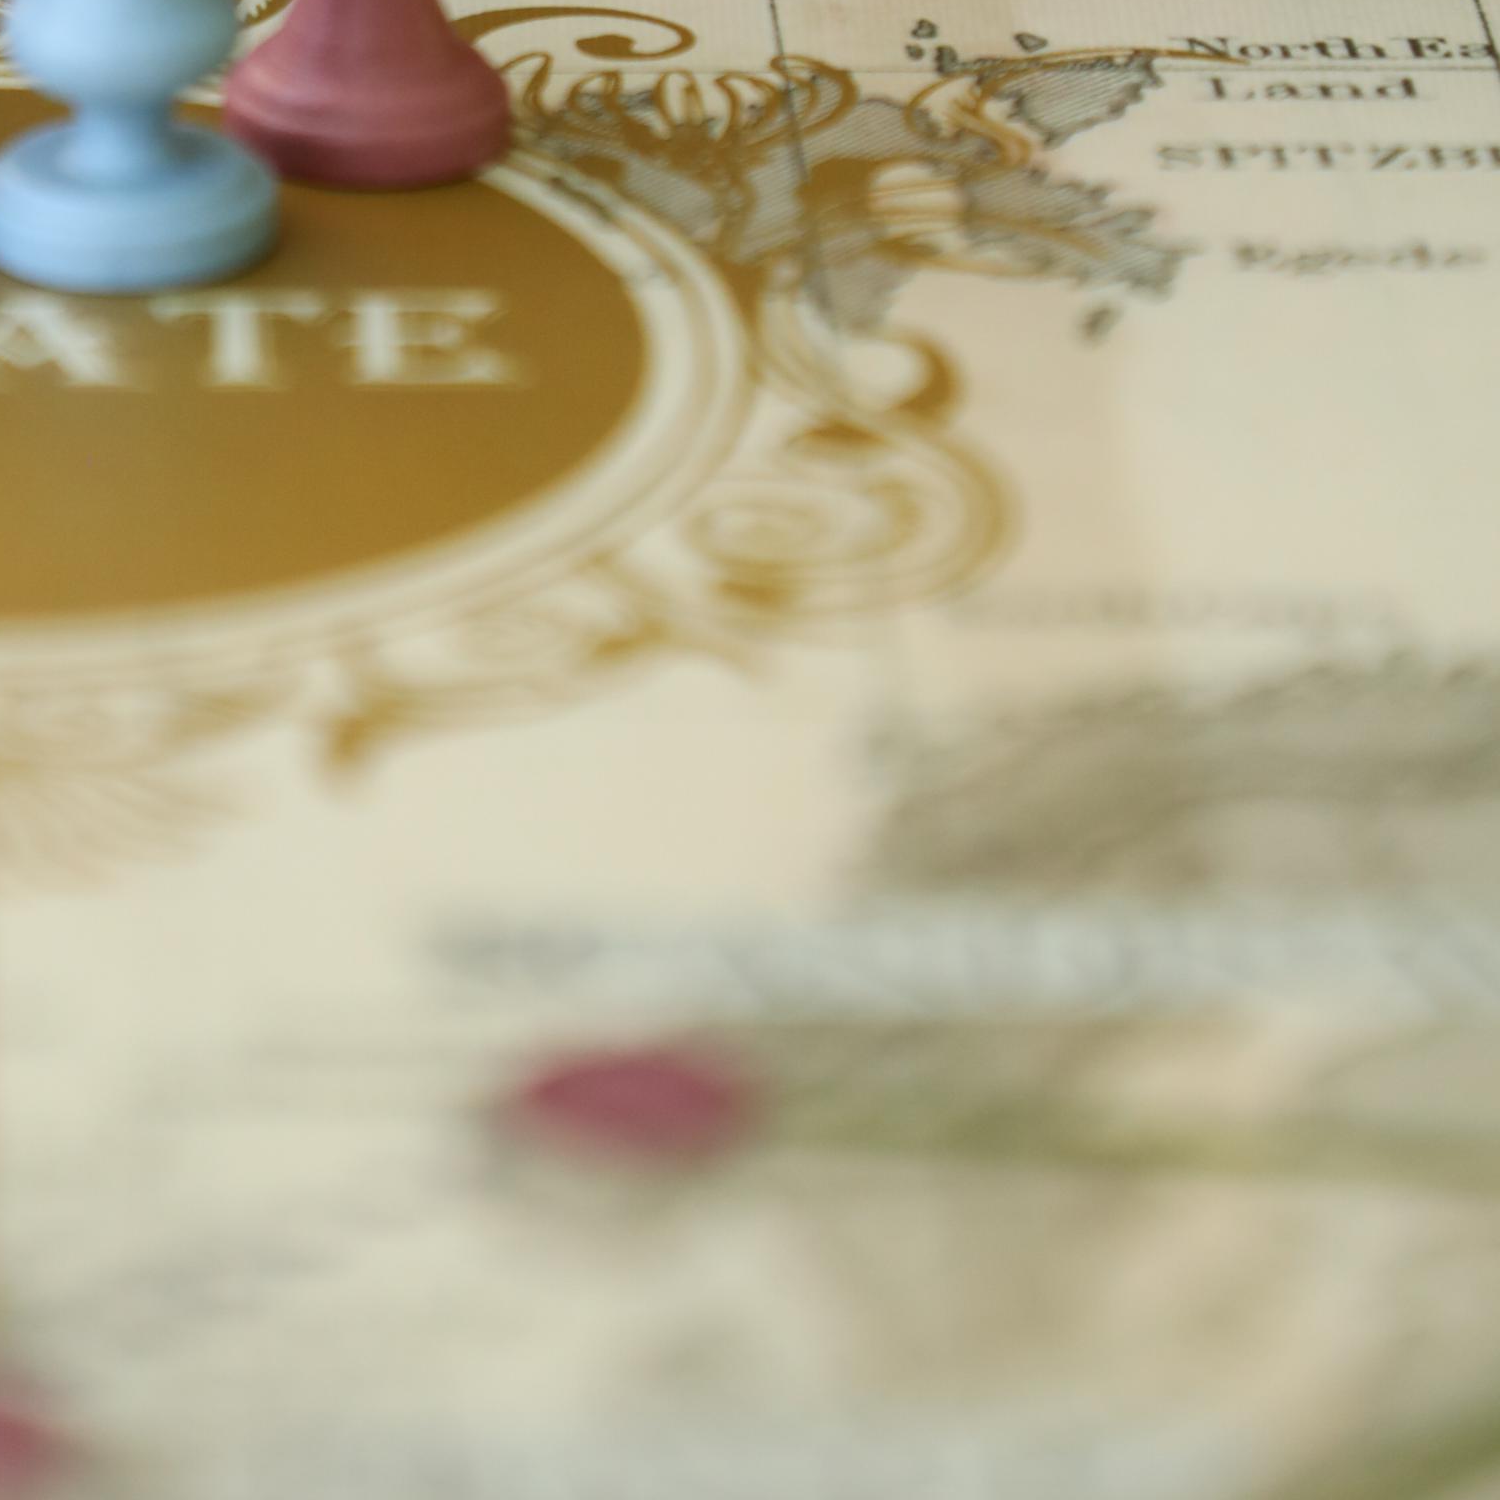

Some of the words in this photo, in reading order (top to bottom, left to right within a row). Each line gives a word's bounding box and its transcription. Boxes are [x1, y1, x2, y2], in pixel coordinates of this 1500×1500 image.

[1168, 35, 1392, 60] North
[1204, 75, 1420, 101] Land
[1154, 143, 1500, 172] SPITZB
